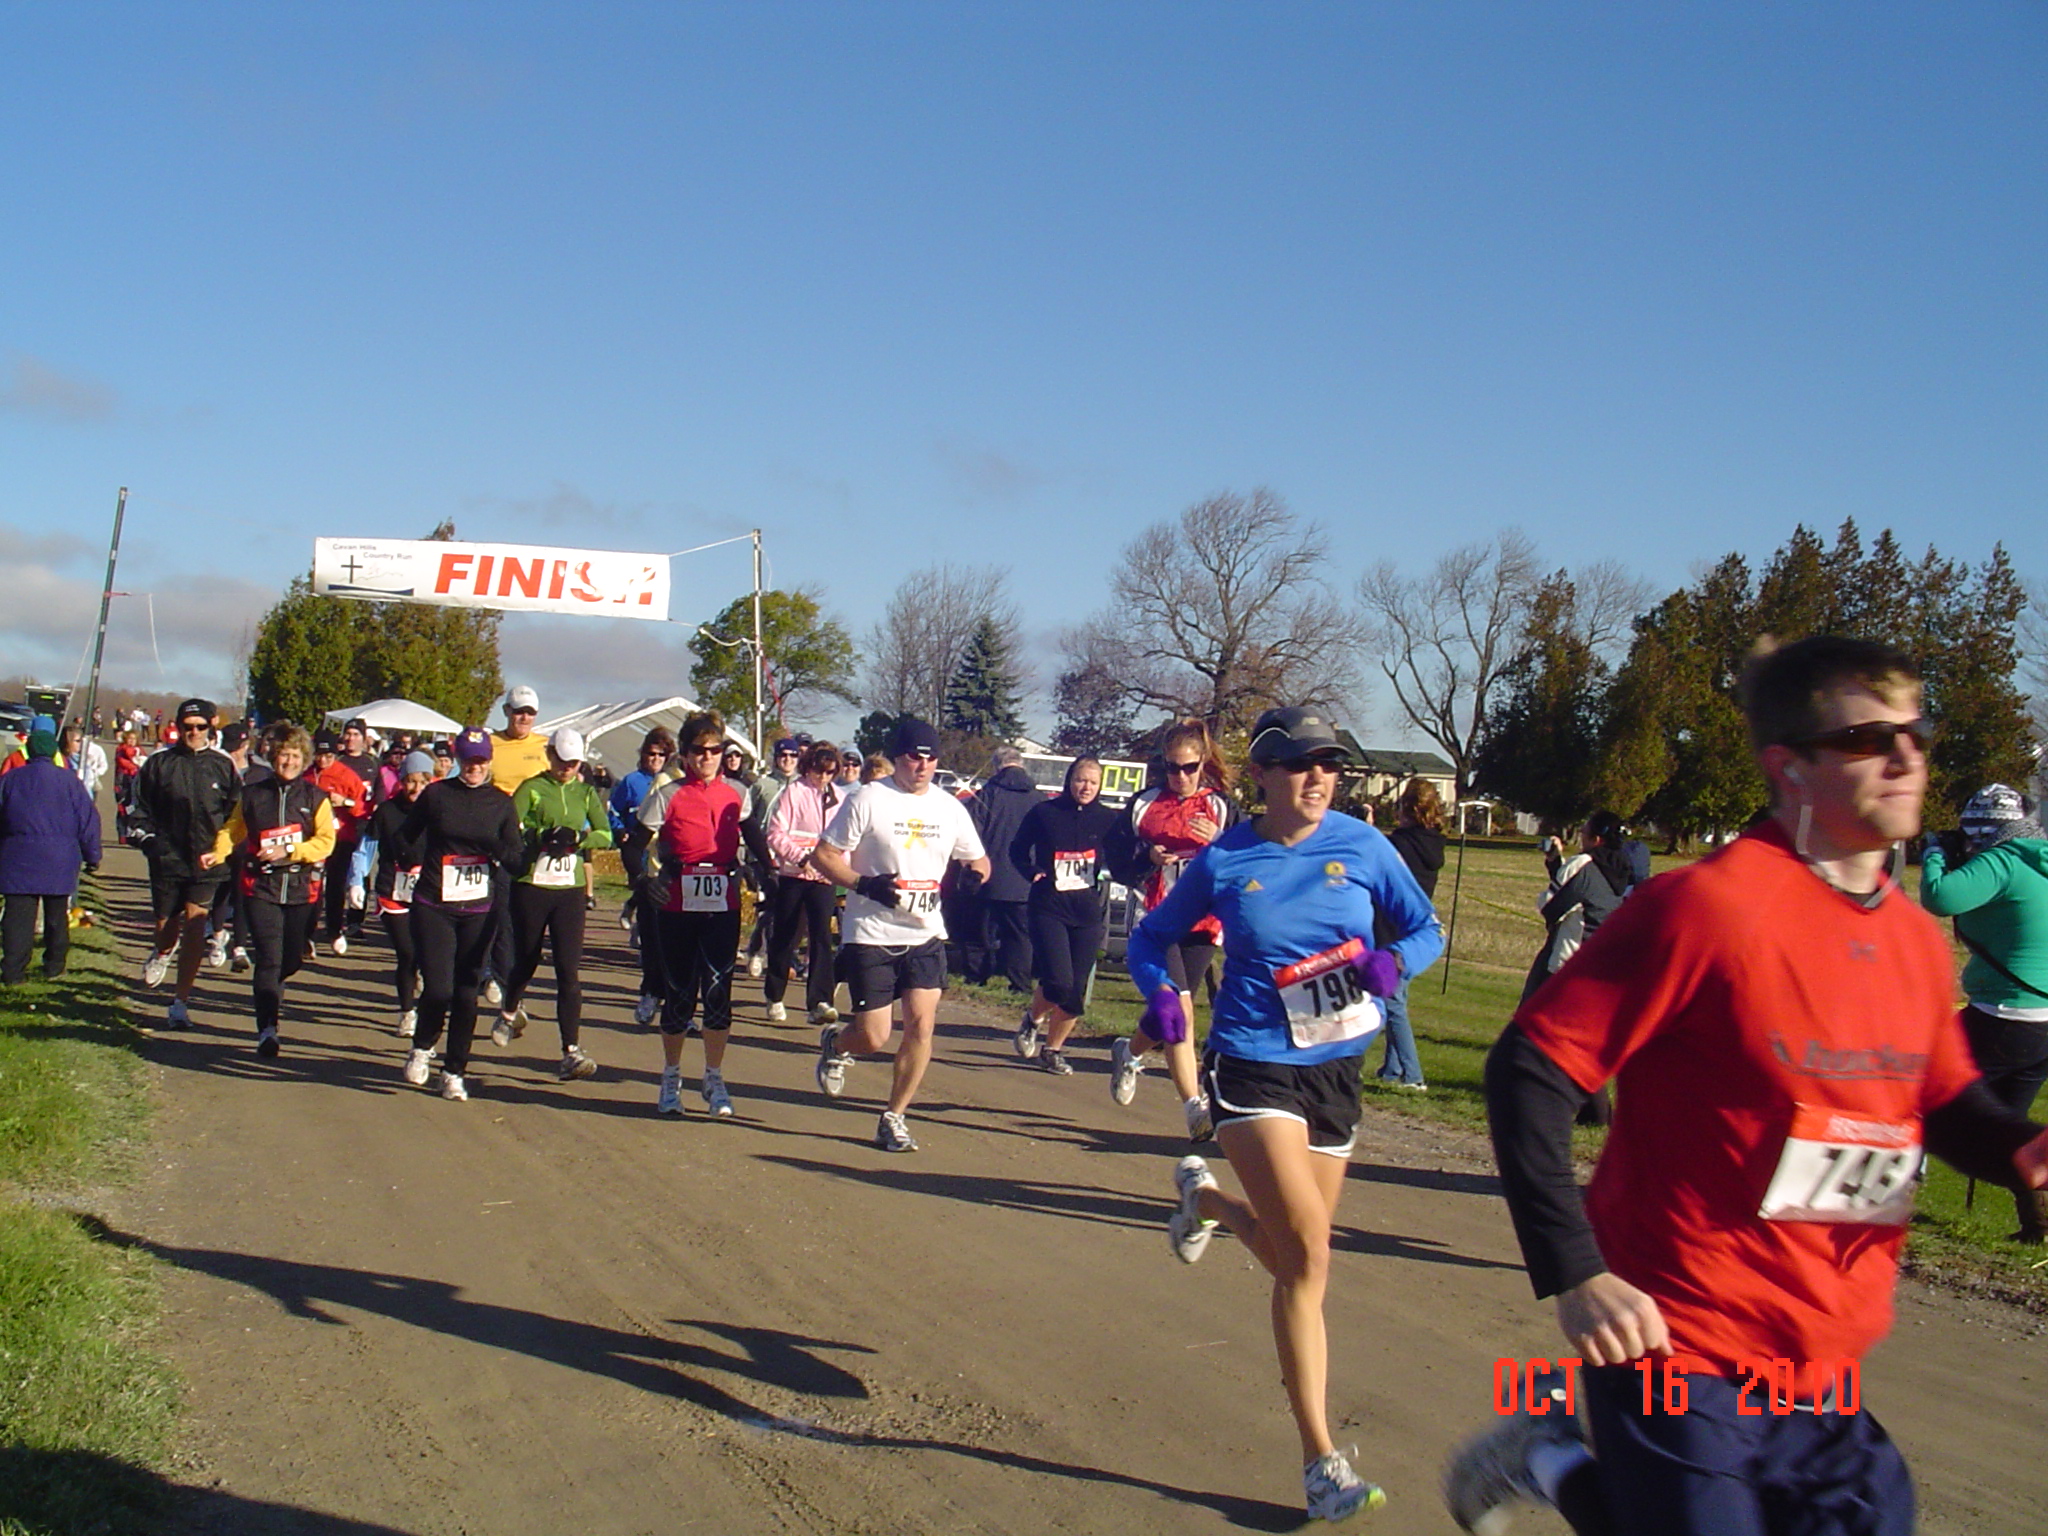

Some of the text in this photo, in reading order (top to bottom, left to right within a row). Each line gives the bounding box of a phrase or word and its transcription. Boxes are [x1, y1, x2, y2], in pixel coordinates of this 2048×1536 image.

[363, 551, 394, 560] Country
[907, 822, 940, 831] SUPPORT
[911, 830, 941, 839] TROOPS
[454, 865, 483, 887] 740
[1065, 860, 1089, 877] 704
[693, 876, 722, 897] 703
[907, 892, 937, 913] 748
[1302, 965, 1364, 1018] 798
